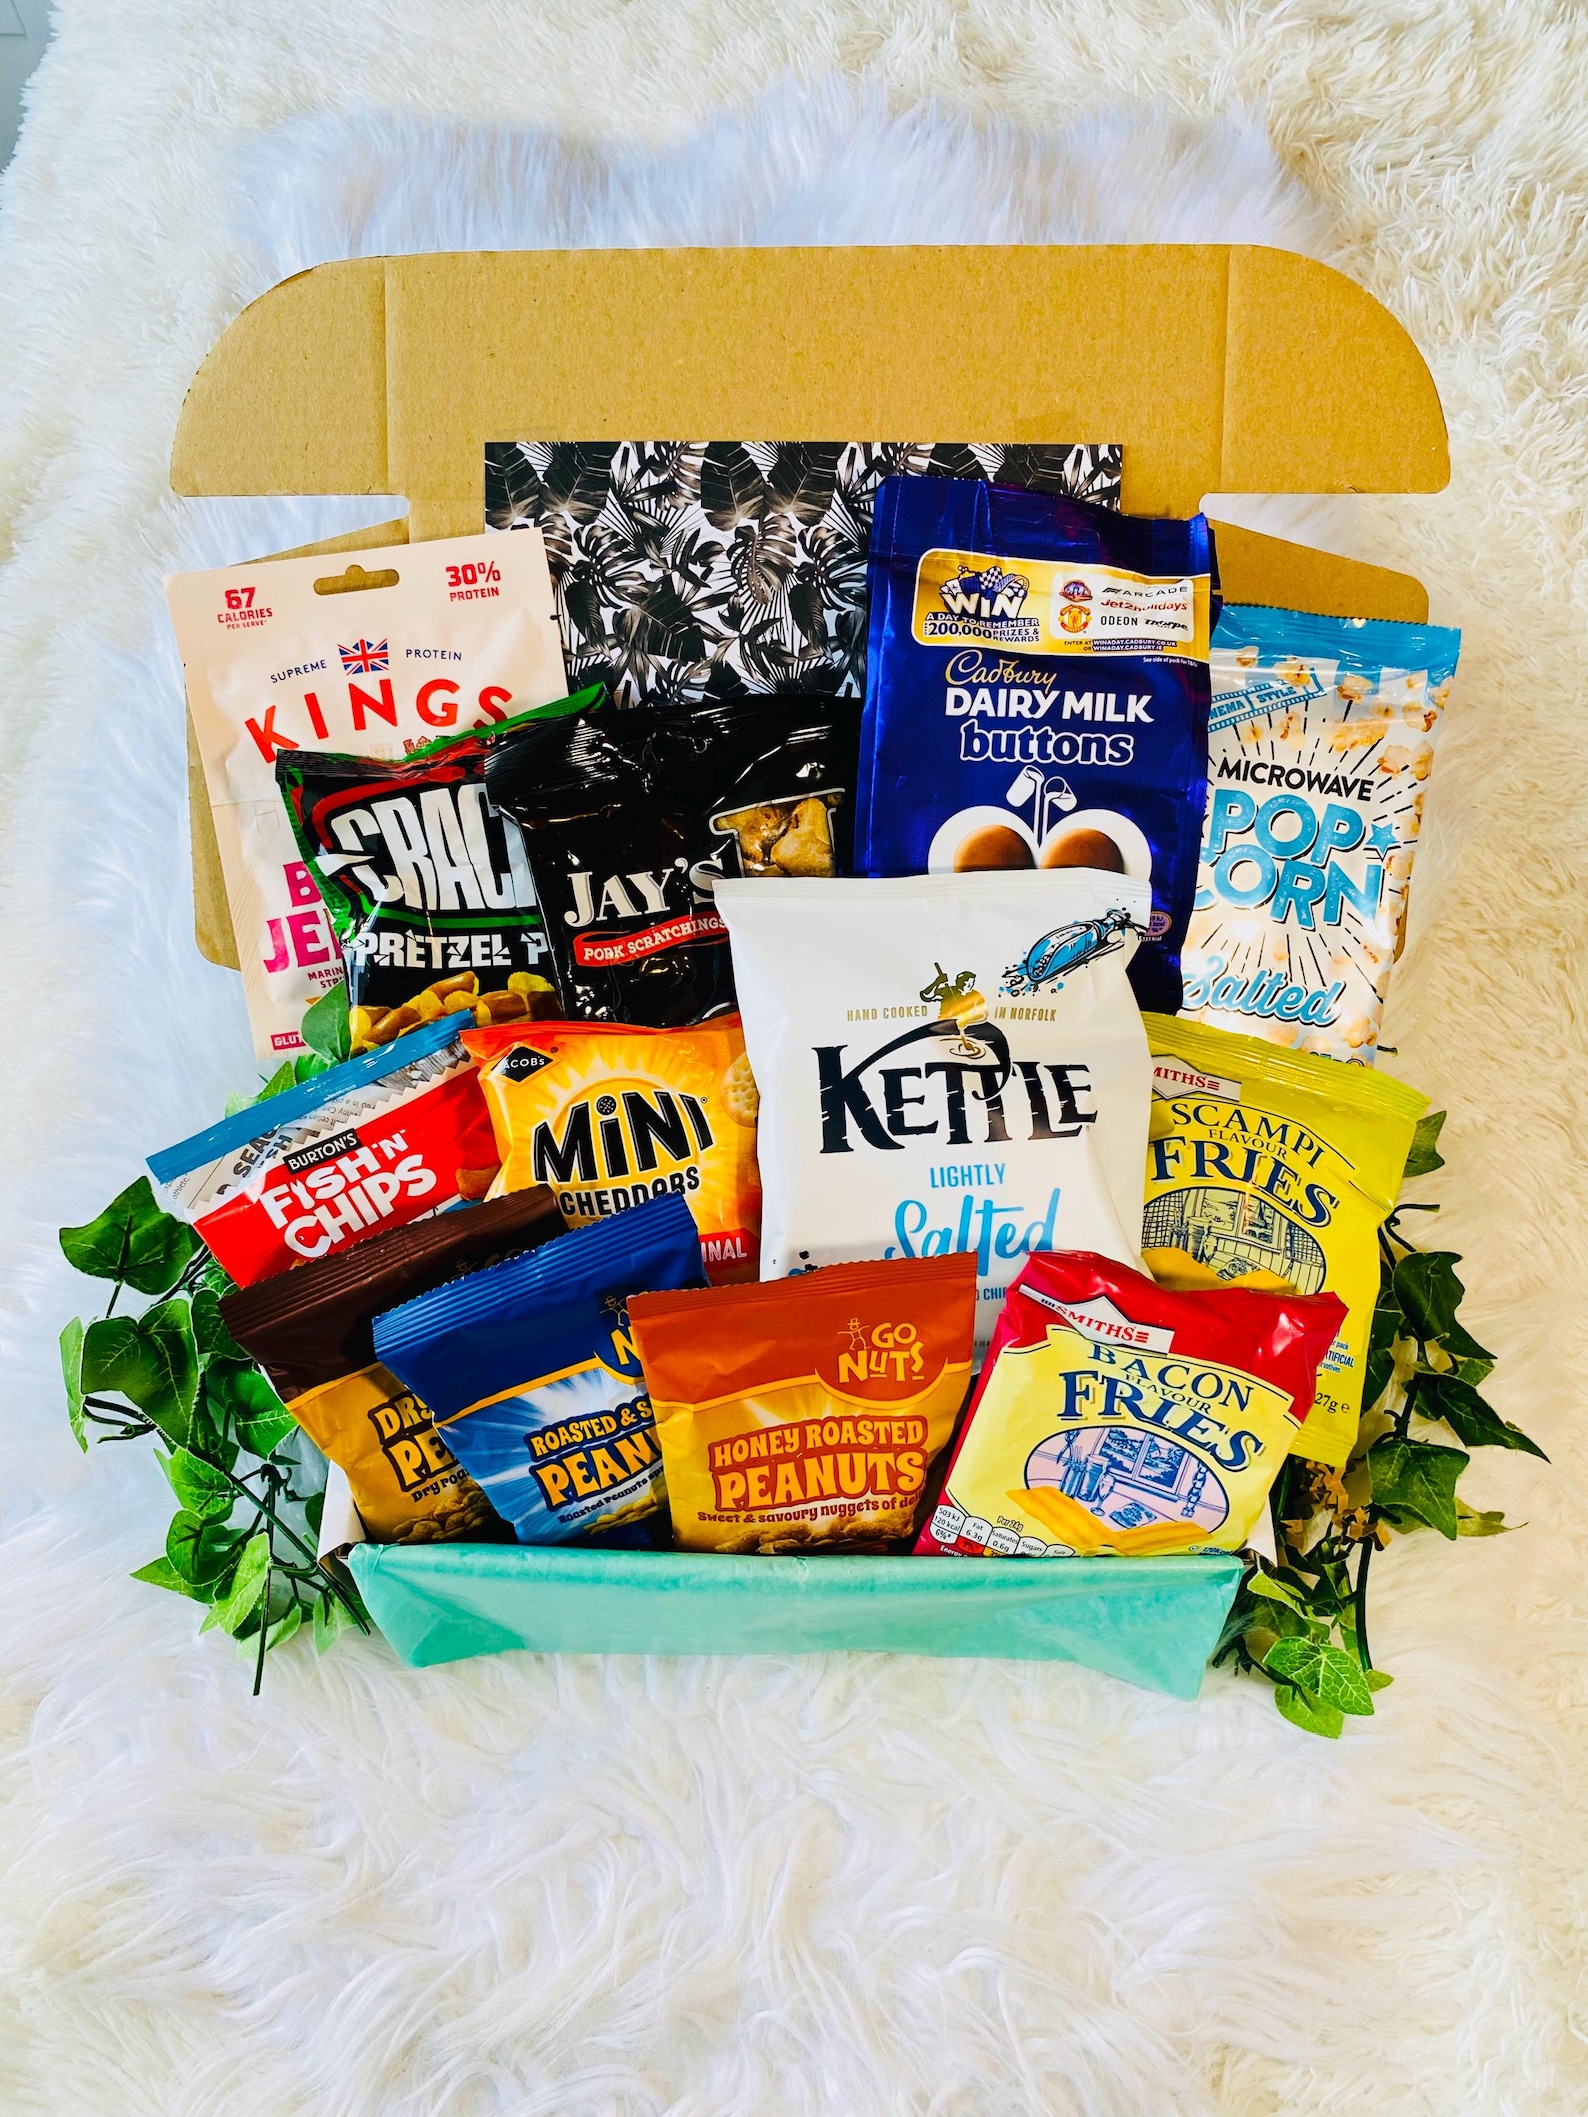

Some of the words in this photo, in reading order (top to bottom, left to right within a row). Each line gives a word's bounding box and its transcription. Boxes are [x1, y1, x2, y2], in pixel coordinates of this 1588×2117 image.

[445, 560, 501, 587] 30%
[225, 586, 256, 610] 67
[449, 586, 500, 602] PROTEIN
[941, 592, 1023, 619] WIN
[217, 607, 273, 624] CALORIES
[226, 623, 240, 631] PER
[926, 612, 935, 621] A
[937, 613, 959, 621] DAY
[962, 616, 977, 626] TO
[979, 618, 1040, 629] REMEMBER
[1100, 615, 1138, 626] ODEON
[928, 622, 992, 639] 200,000
[992, 628, 1030, 637] PRIZES
[1033, 628, 1040, 636] &
[992, 635, 1040, 643] REWARDS
[405, 648, 462, 661] PROTEIN
[270, 659, 327, 684] SUPREME
[945, 649, 1057, 695] Cadbury
[945, 687, 1060, 719] DAIRY
[1061, 691, 1155, 723] MILK
[1256, 686, 1297, 703] STYLE
[245, 678, 512, 764] KINGS
[960, 718, 1135, 766] buttons
[1218, 756, 1375, 802] MICROWAVE
[1209, 788, 1366, 868] POP
[563, 857, 726, 928] JAY'S
[346, 929, 512, 970] PRETZEL
[583, 945, 625, 962] PORK
[626, 916, 726, 955] SCRATCHINGS
[1182, 954, 1346, 1029] Salted
[847, 1007, 878, 1021] HAND
[883, 1005, 928, 1020] COOKED
[994, 1006, 1005, 1019] IN
[1010, 1007, 1057, 1022] NORFOLK
[812, 1019, 1098, 1154] KETTLE
[1171, 1102, 1326, 1170] SCAMPI
[1207, 1129, 1289, 1160] FLAVOUR
[288, 1132, 358, 1171] BURTON'S
[260, 1145, 382, 1229] FISH
[929, 1163, 1006, 1189] LIGHTLY
[1150, 1136, 1339, 1227] FRIES
[284, 1153, 437, 1258] CHIPS
[884, 1187, 1061, 1276] Salted
[871, 1322, 917, 1346] GO
[1056, 1305, 1136, 1342] SMITHS
[1088, 1344, 1254, 1412] BACON
[1125, 1374, 1212, 1415] FLAVOUR
[1314, 1392, 1339, 1414] 27g
[531, 1415, 617, 1457] ROASTED
[620, 1407, 638, 1427] &
[1058, 1370, 1267, 1472] FRIES
[714, 1425, 800, 1468] HONEY
[805, 1420, 923, 1450] ROASTED
[411, 1481, 440, 1503] Dry
[717, 1451, 924, 1510] PEANUTS
[557, 1500, 605, 1525] Roasted
[604, 1478, 648, 1503] Peanuts
[698, 1511, 740, 1523] Sweet
[743, 1514, 756, 1523] &
[758, 1507, 818, 1523] savoury
[820, 1500, 879, 1517] nuggets
[882, 1497, 897, 1510] of
[939, 1507, 952, 1518] 503
[951, 1513, 961, 1522] kJ
[934, 1515, 946, 1526] 120
[945, 1520, 961, 1532] kcal
[965, 1529, 984, 1542] 6.3g
[972, 1521, 984, 1531] Fat
[991, 1529, 1019, 1545] Saturates
[992, 1540, 1010, 1553] 0.6g
[1021, 1540, 1043, 1552] Sugars
